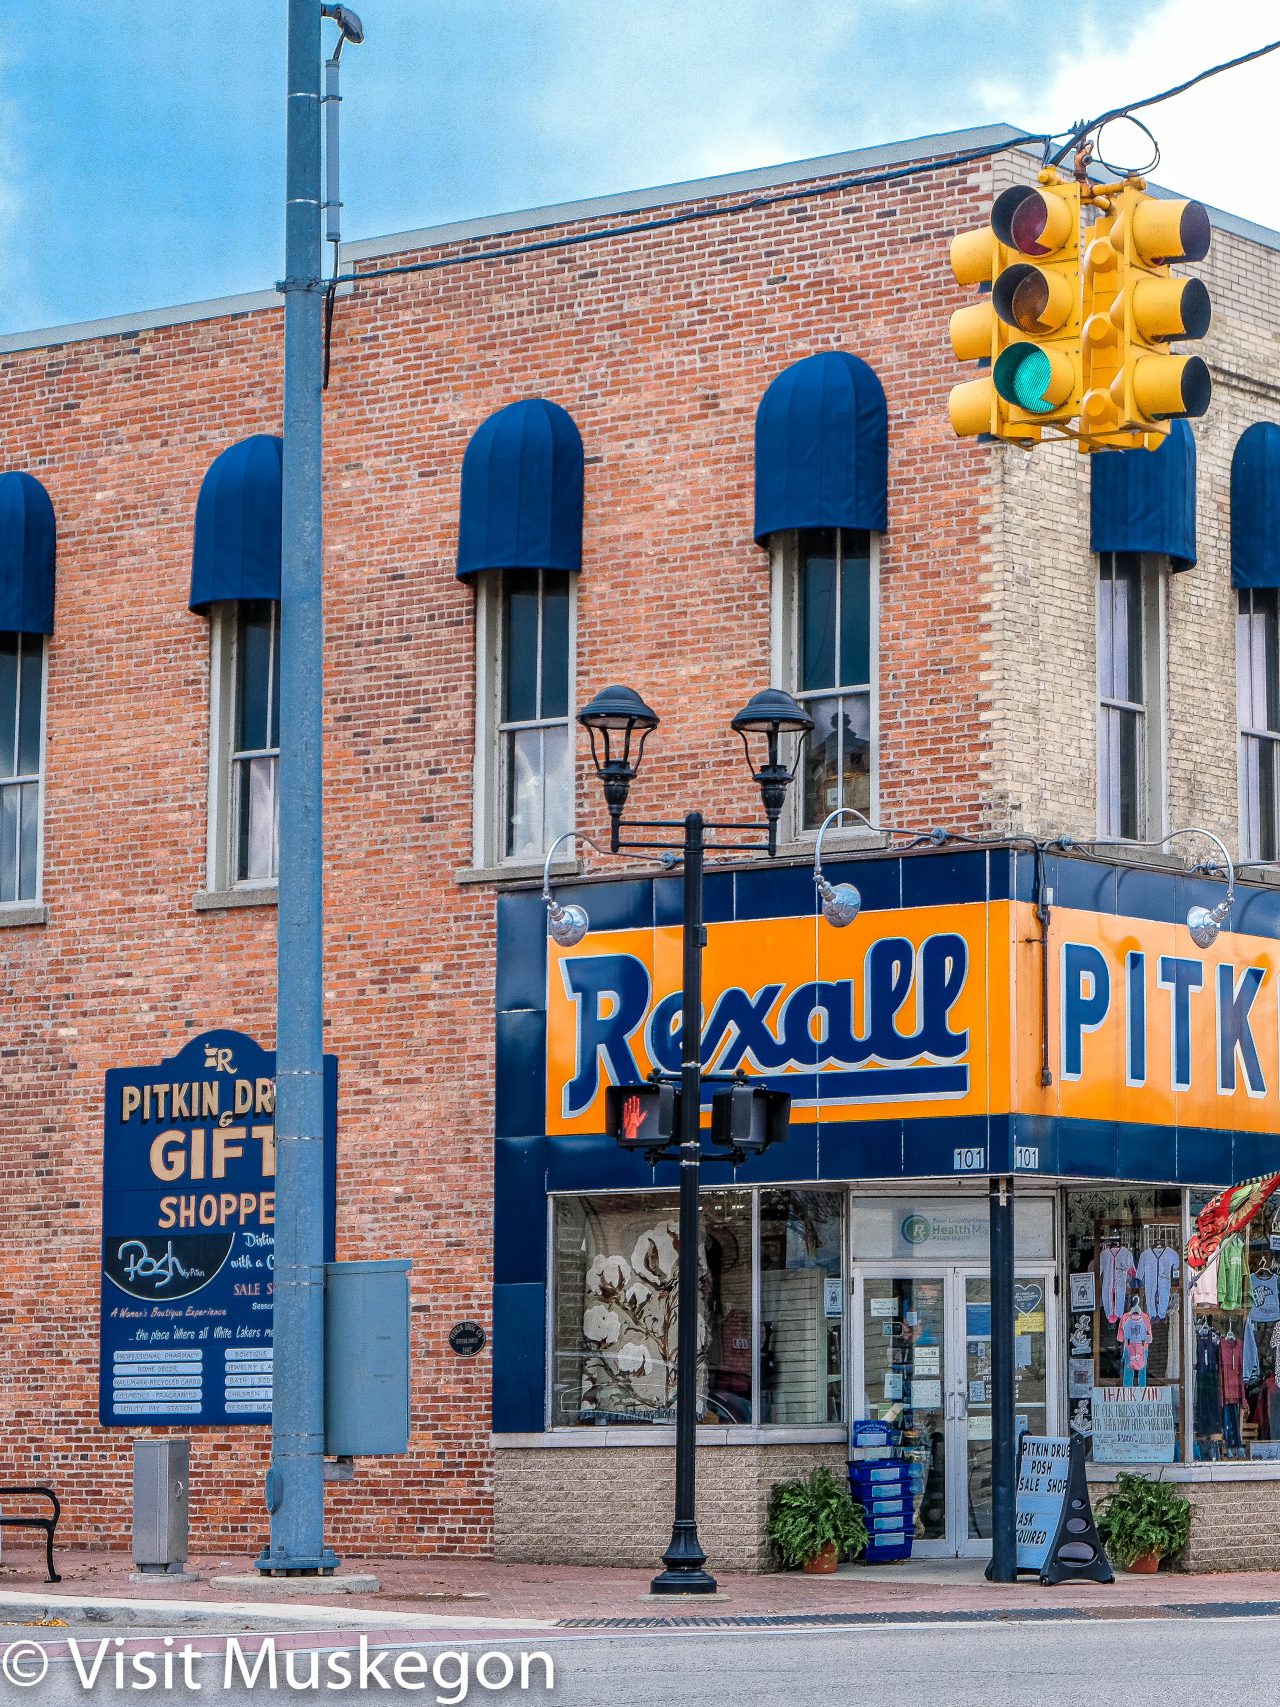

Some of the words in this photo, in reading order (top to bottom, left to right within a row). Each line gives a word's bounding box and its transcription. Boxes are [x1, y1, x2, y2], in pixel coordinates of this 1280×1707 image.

[558, 931, 970, 1119] Rexall
[122, 1080, 220, 1122] PITKIN
[234, 1077, 274, 1114] DR
[150, 1125, 275, 1182] GIFT
[956, 1149, 982, 1168] 101
[1018, 1148, 1037, 1168] 101
[158, 1191, 275, 1229] SHOPPE
[118, 1240, 184, 1288] Posh
[230, 1254, 253, 1270] with
[256, 1259, 263, 1268] a
[233, 1283, 261, 1297] SALE
[150, 1305, 183, 1320] Boutique
[185, 1305, 227, 1318] Experience
[198, 1327, 209, 1339] all
[236, 1324, 261, 1338] Lakers
[116, 1352, 160, 1361] PROFESSIONAL
[164, 1352, 200, 1360] PHARMACY
[115, 1392, 150, 1400] COSMETICS
[227, 1391, 260, 1399] CHILDREN
[1104, 1387, 1137, 1402] THANK
[148, 1405, 160, 1413] PAY
[1023, 1442, 1049, 1458] PITKIN
[1031, 1460, 1053, 1476] POSH
[1019, 1477, 1040, 1492] SALE
[1046, 1479, 1067, 1494] SHOP
[1017, 1512, 1035, 1527] ASK
[1016, 1529, 1046, 1545] QUIRED
